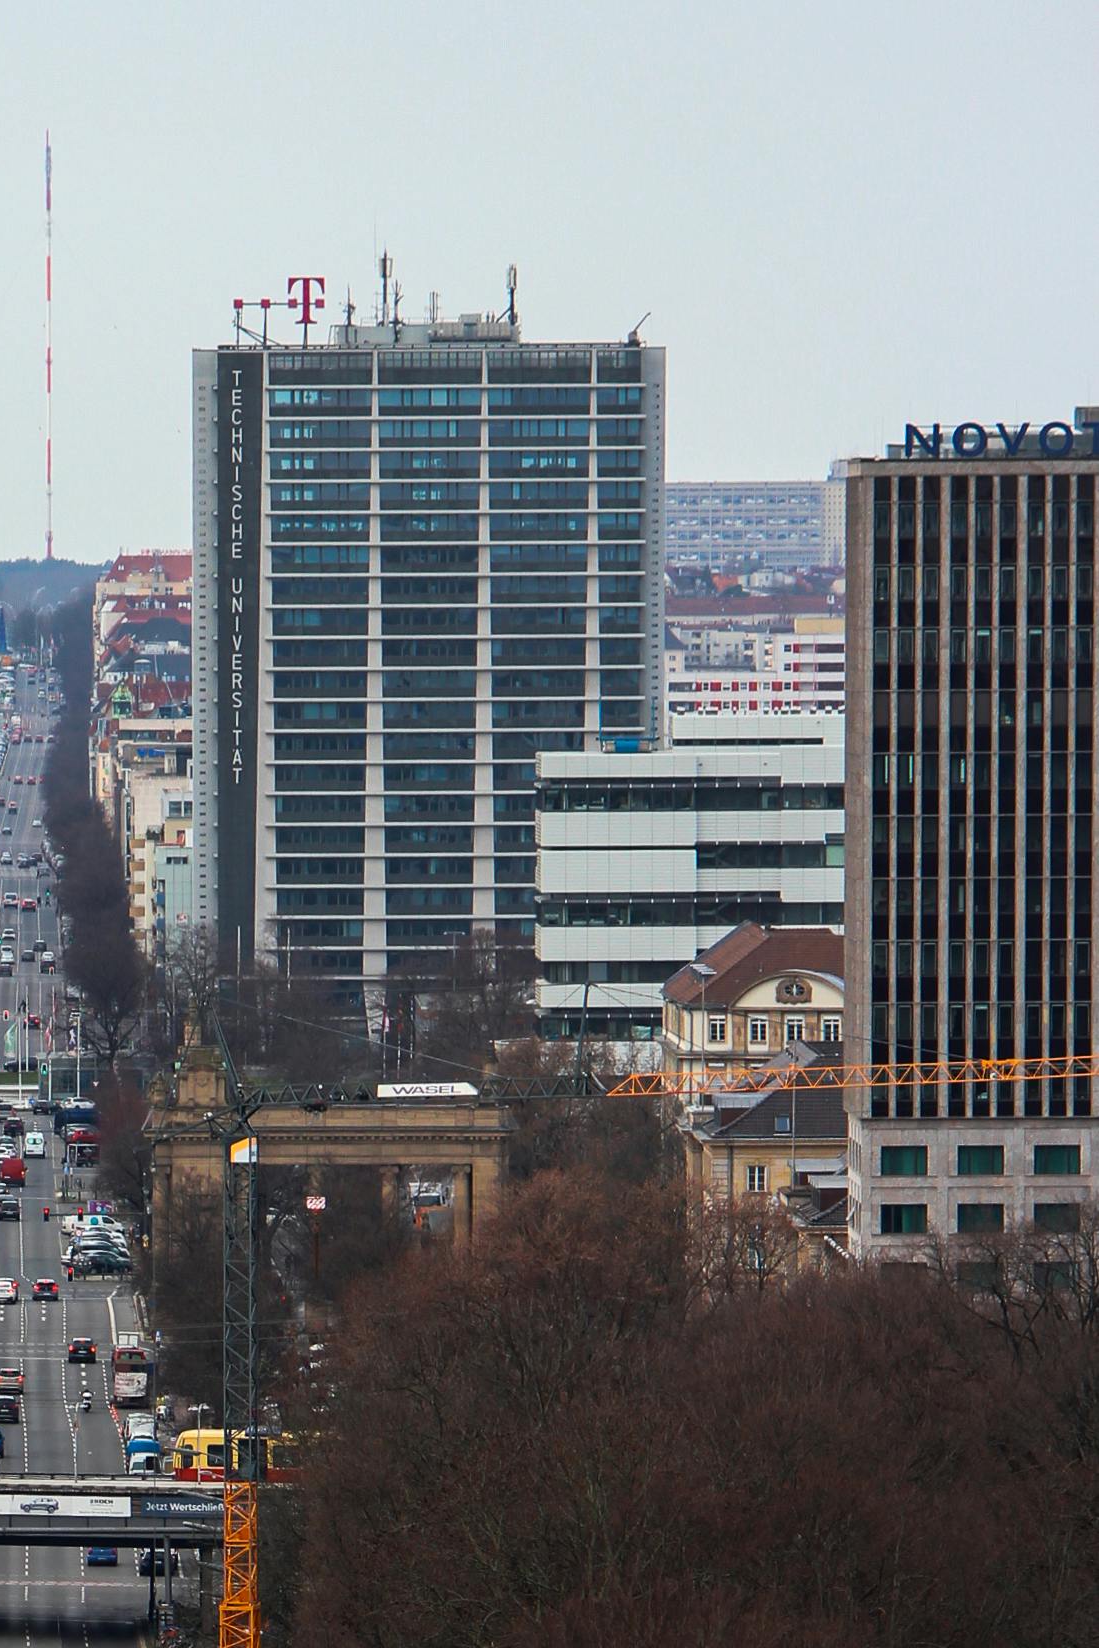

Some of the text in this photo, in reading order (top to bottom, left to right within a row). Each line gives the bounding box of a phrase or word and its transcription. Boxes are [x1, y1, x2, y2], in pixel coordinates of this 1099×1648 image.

[230, 370, 243, 784] TECHNISCHE UNIVERSITÄT
[391, 1084, 462, 1095] WASEL
[146, 1502, 168, 1511] Jetzt
